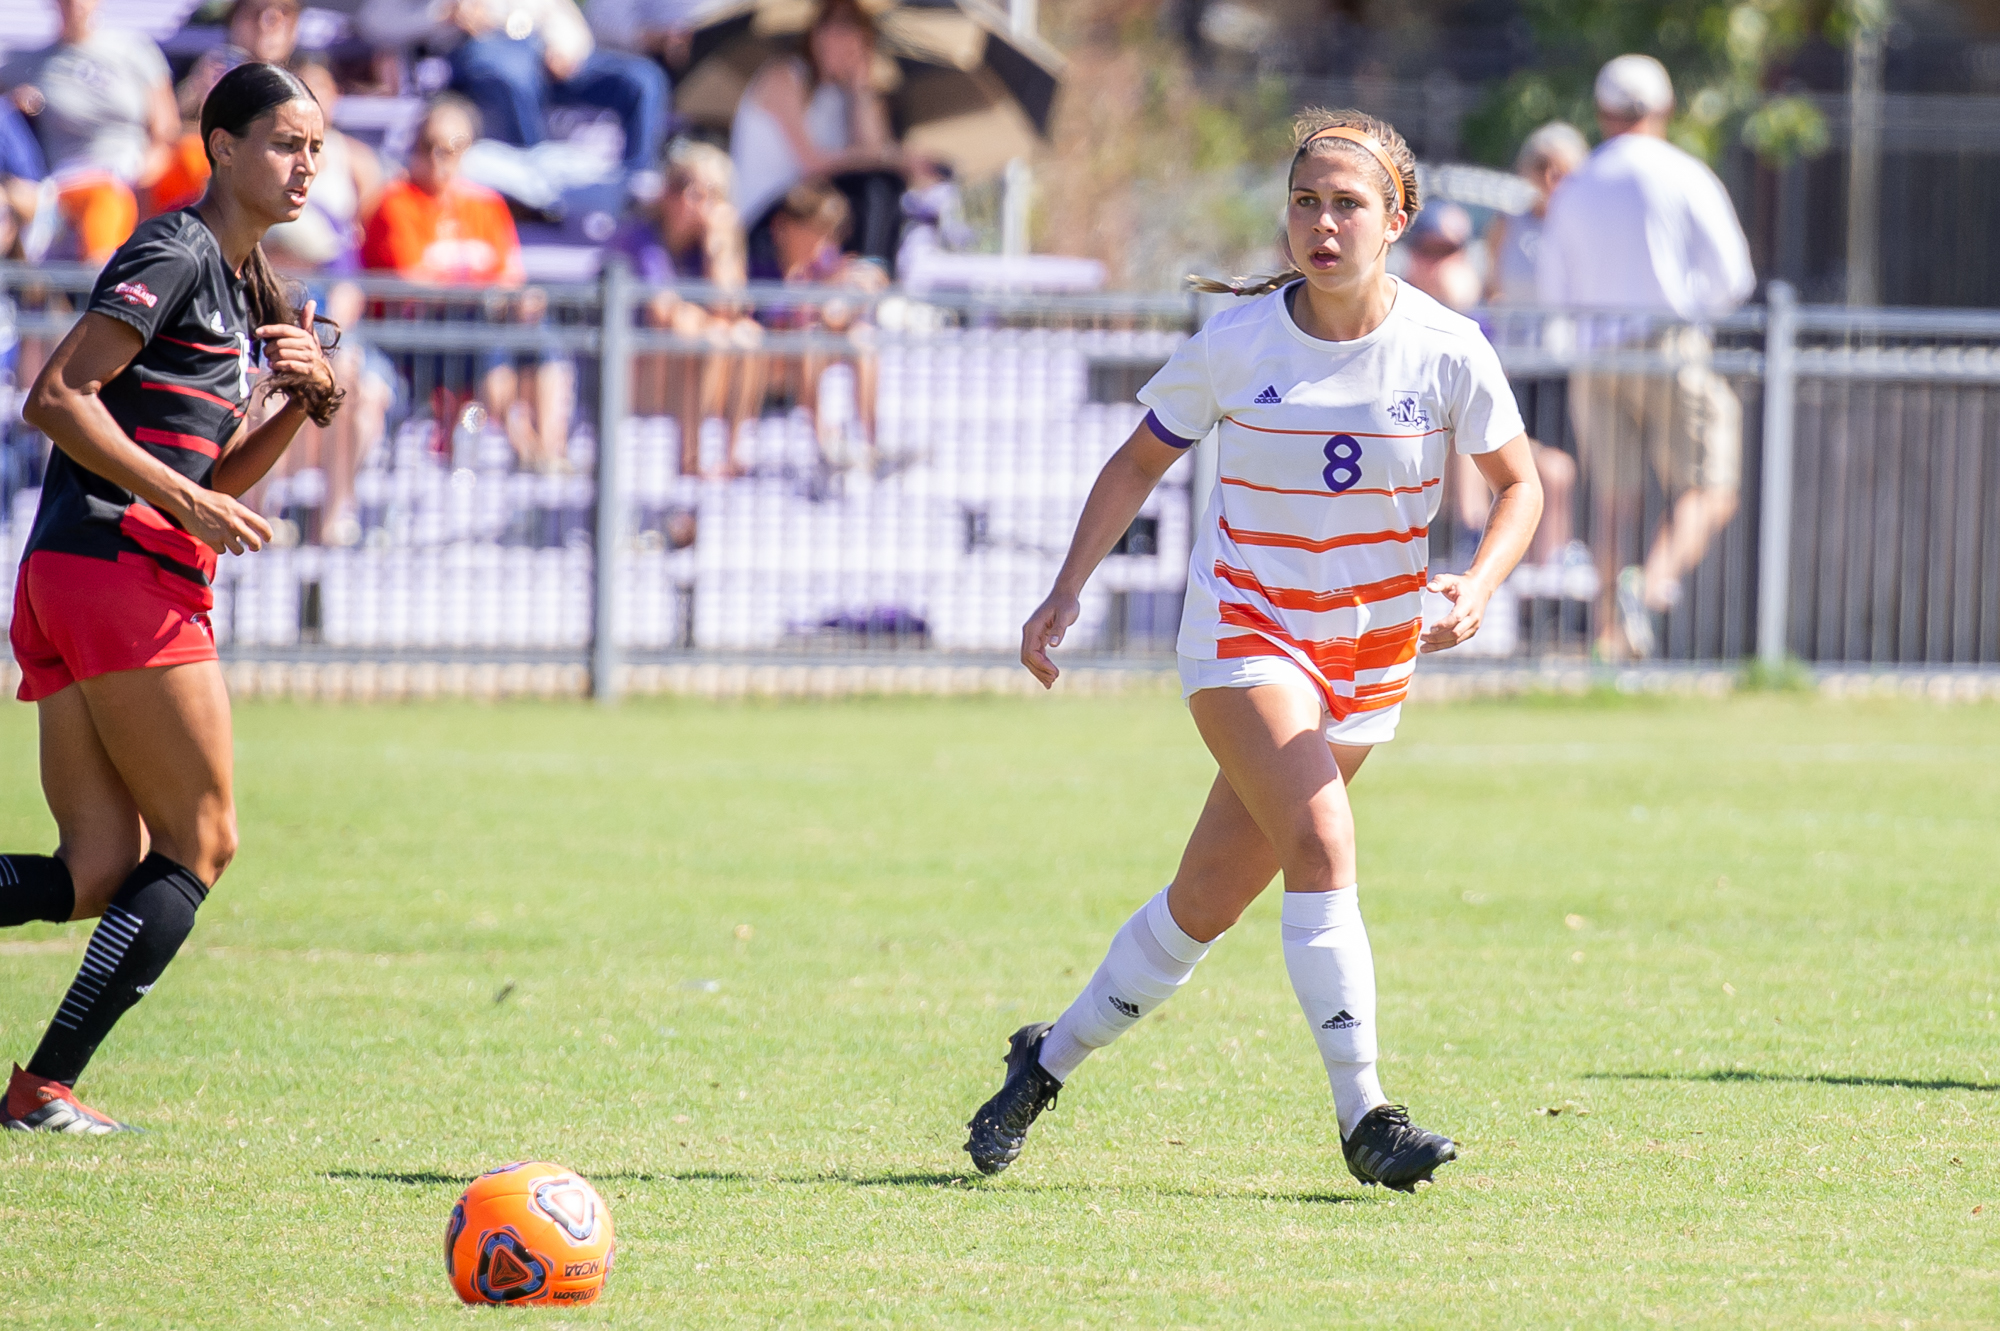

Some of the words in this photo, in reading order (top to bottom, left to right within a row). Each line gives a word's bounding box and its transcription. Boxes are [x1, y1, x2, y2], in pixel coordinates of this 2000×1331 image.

[1398, 403, 1415, 422] N
[1322, 433, 1363, 493] 8
[1108, 996, 1141, 1018] adidas
[1321, 1019, 1362, 1030] adidas
[564, 1260, 600, 1277] NCAA
[552, 1287, 596, 1302] Wilson
